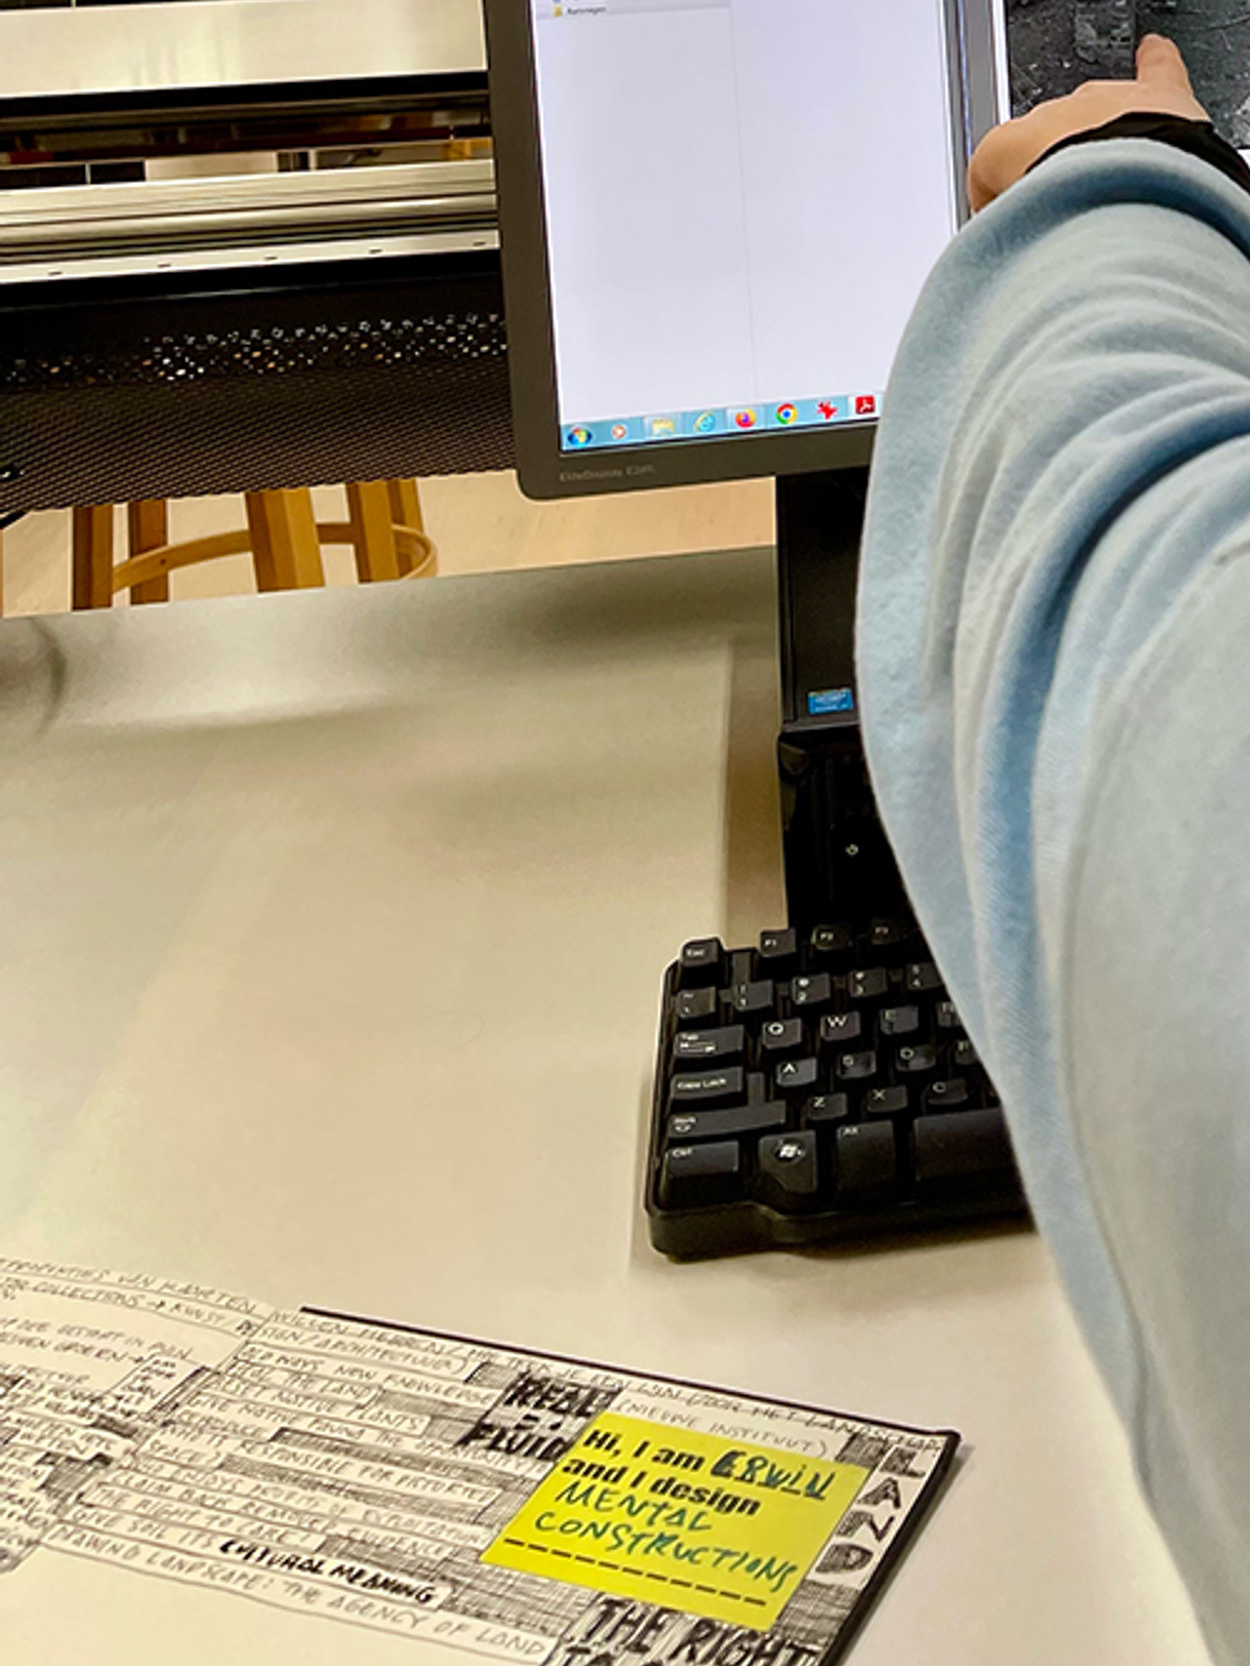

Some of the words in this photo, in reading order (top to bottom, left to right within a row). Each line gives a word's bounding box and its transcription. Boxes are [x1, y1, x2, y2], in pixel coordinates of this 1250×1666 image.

[827, 1016, 847, 1028] W
[783, 1062, 796, 1074] A
[872, 1089, 886, 1100] X
[582, 1429, 623, 1458] Hi,
[632, 1440, 651, 1458] I
[652, 1447, 706, 1472] am
[555, 1481, 712, 1533] MENTAL
[562, 1457, 631, 1485] and
[629, 1470, 647, 1487] I
[649, 1476, 762, 1517] design
[534, 1511, 799, 1594] CONSTRUCTIONS
[329, 1561, 437, 1605] MEANING
[327, 1594, 431, 1629] AGENCY
[433, 1621, 472, 1636] OF
[474, 1625, 547, 1656] LAND
